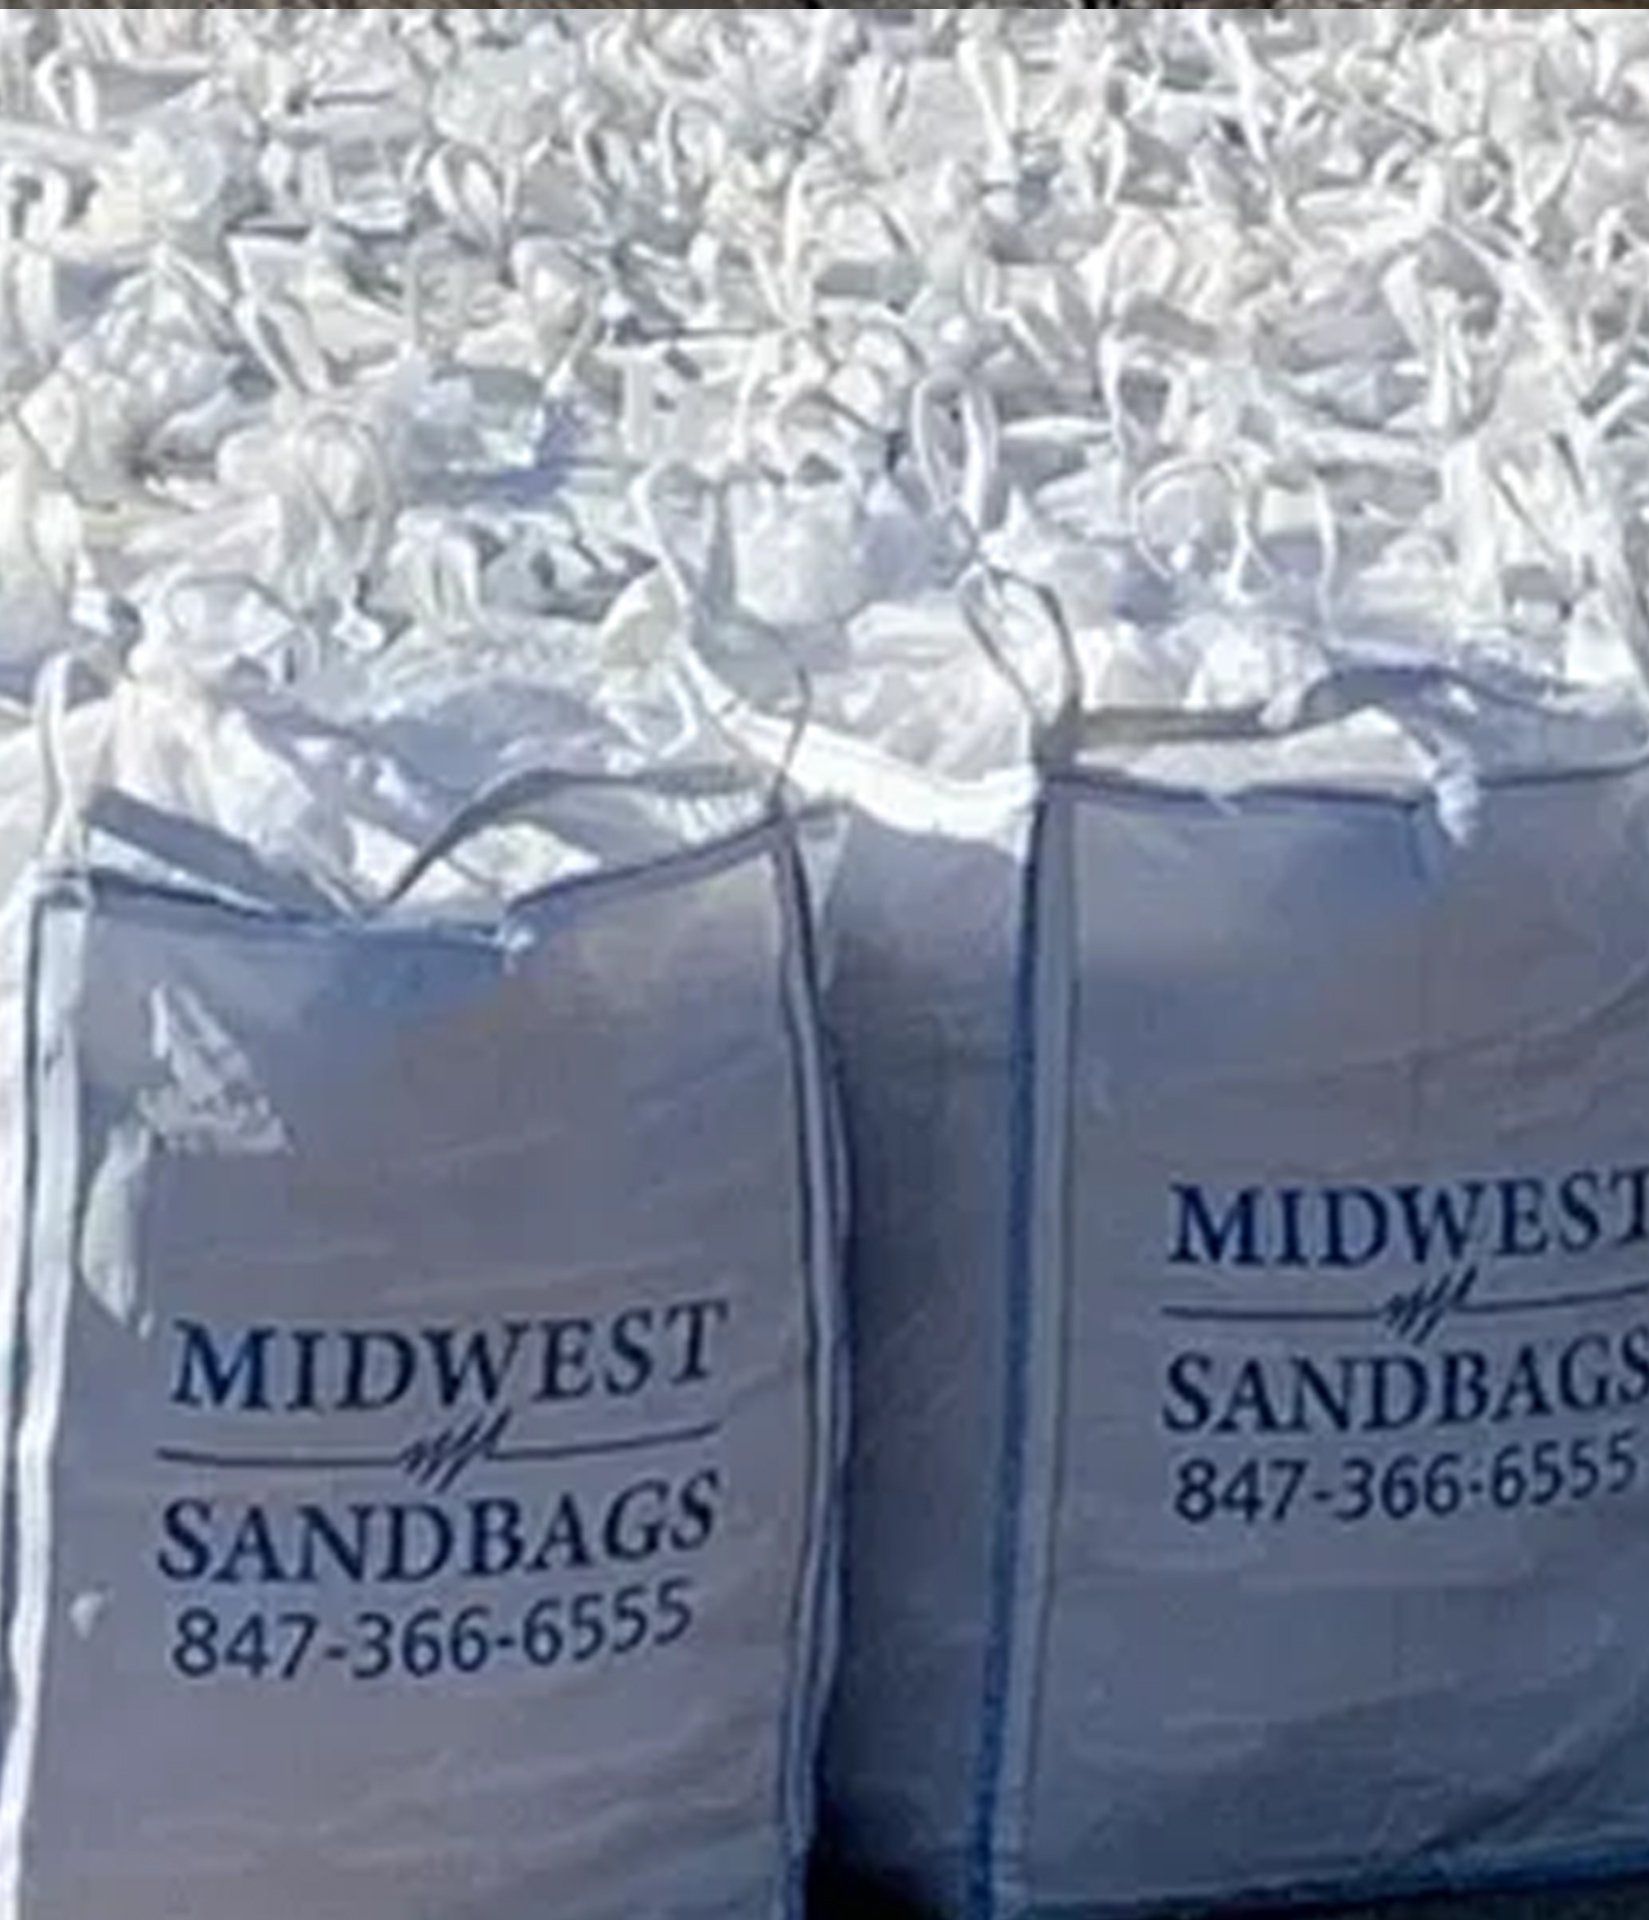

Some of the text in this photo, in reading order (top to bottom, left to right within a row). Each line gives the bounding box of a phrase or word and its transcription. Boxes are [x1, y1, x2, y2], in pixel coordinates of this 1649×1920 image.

[1167, 1166, 1649, 1268] MIDWEST
[171, 1300, 729, 1412] MIDWEST
[1162, 1324, 1649, 1433] SANDBAGS
[157, 1470, 721, 1583] SANDBAGS
[1173, 1427, 1637, 1524] 847-366-6555
[172, 1577, 693, 1678] 847-366-6555
